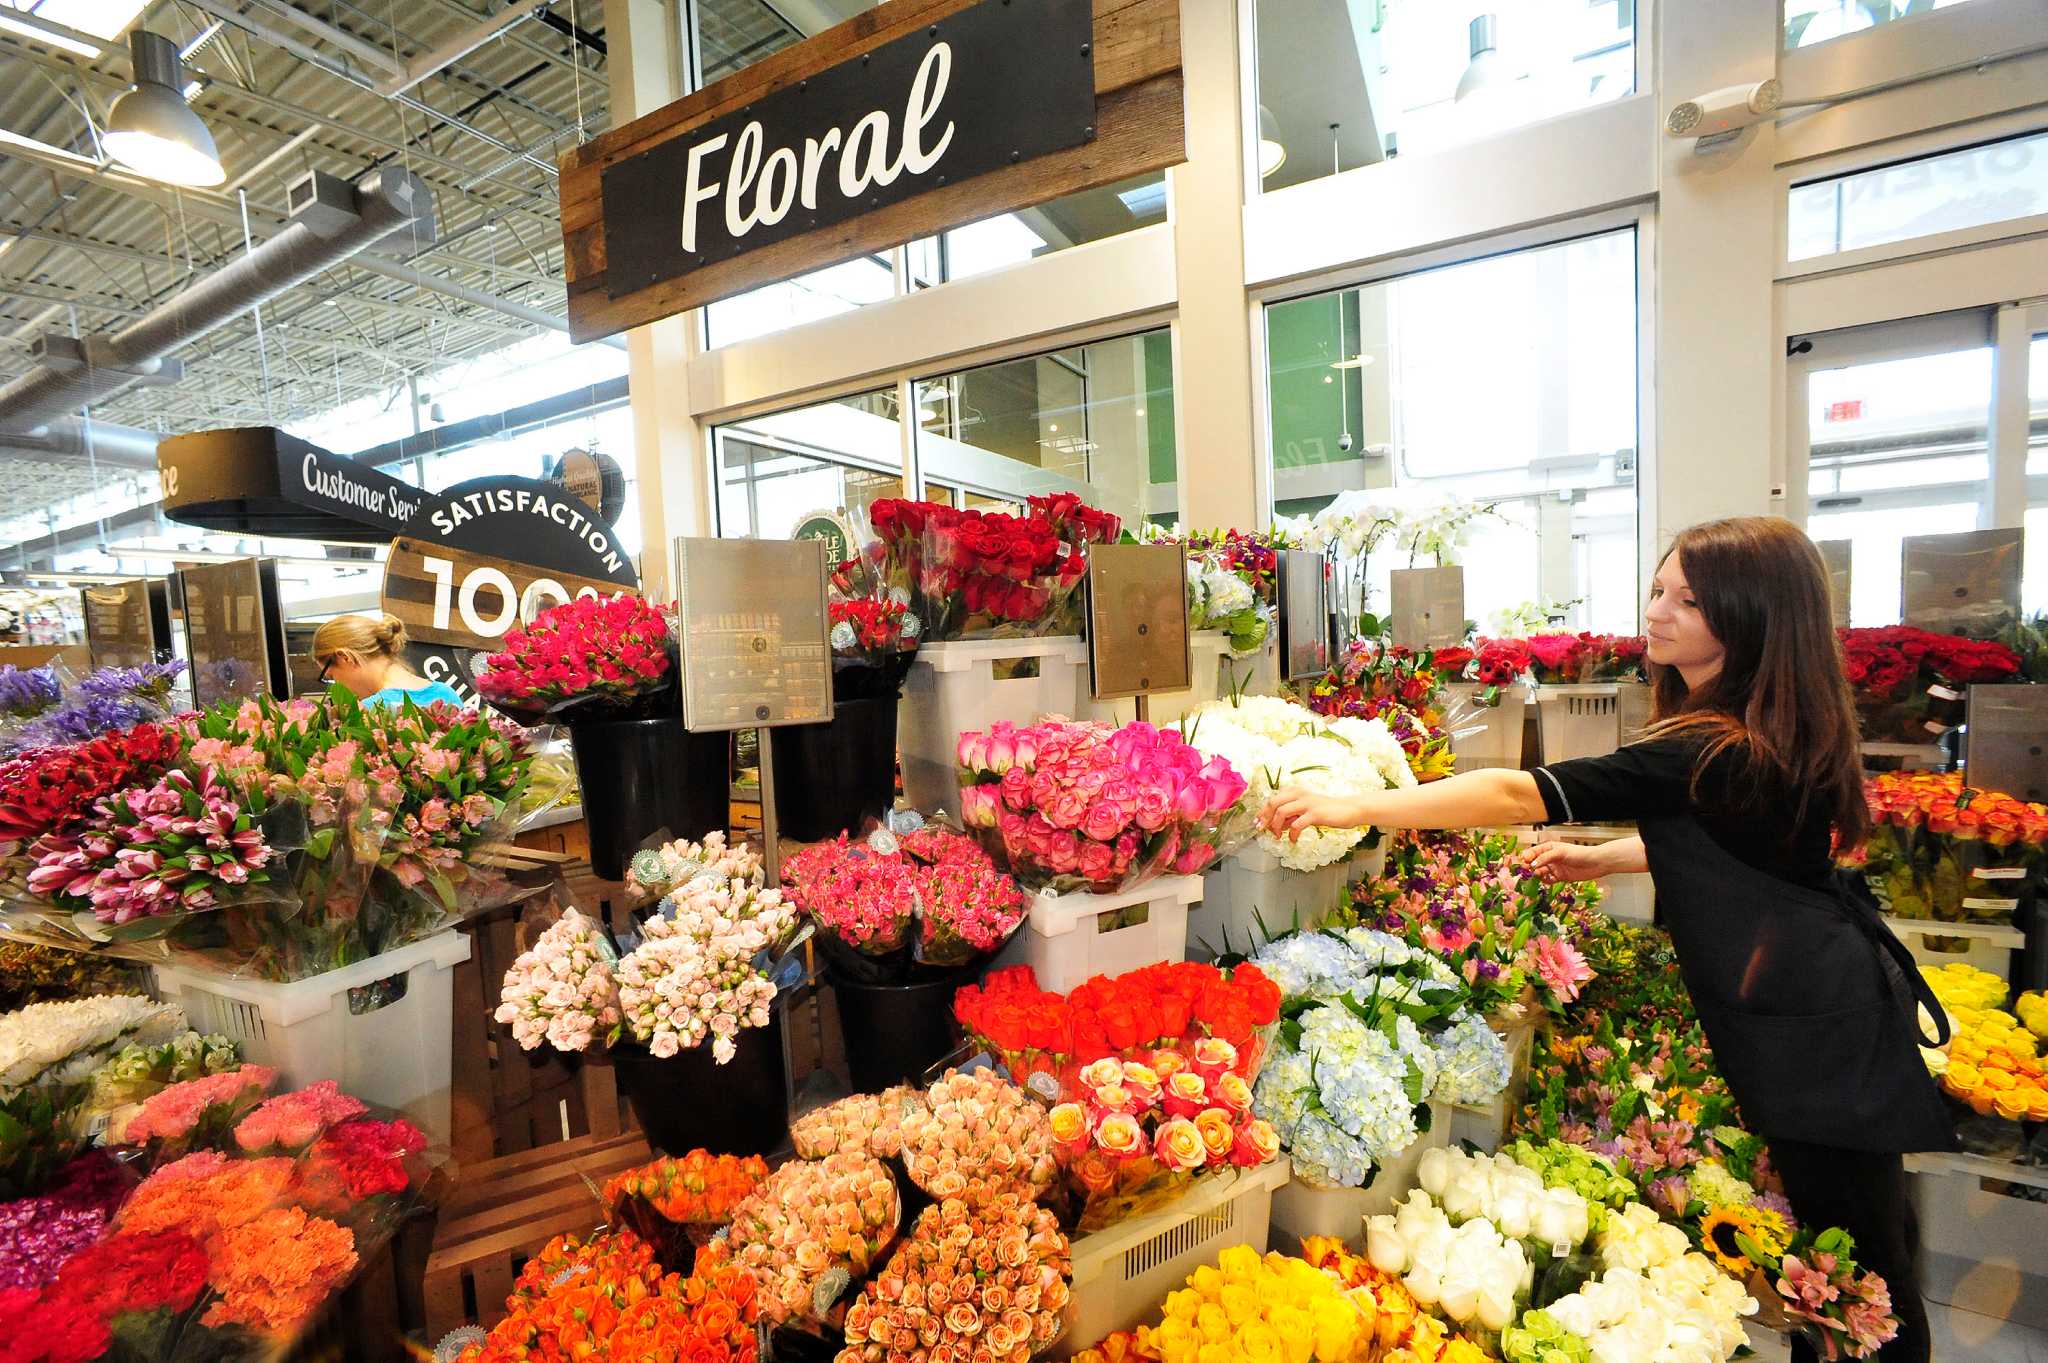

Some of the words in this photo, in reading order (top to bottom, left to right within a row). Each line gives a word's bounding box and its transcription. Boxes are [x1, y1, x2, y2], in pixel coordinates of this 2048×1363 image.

[681, 41, 954, 253] Floral
[303, 453, 385, 514] Customer
[431, 489, 624, 574] SATISFACTION
[423, 556, 624, 638] 100
